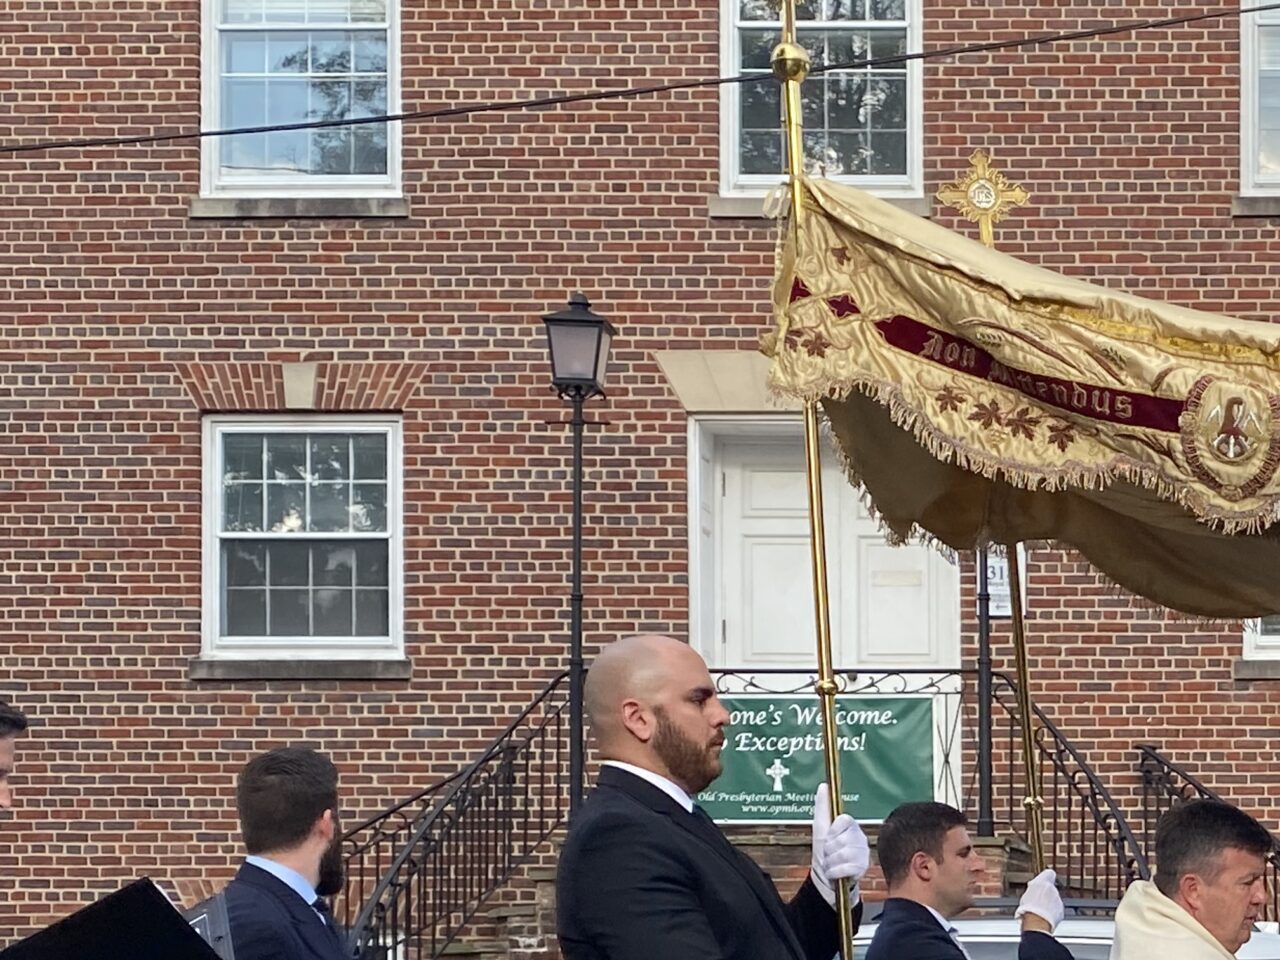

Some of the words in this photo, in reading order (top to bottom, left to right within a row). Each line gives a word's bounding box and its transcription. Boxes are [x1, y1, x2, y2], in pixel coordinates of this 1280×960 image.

[788, 703, 898, 726] Wecome.
[734, 731, 867, 758] Exceptins!
[697, 791, 718, 802] Old
[718, 791, 782, 804] Presbyterian
